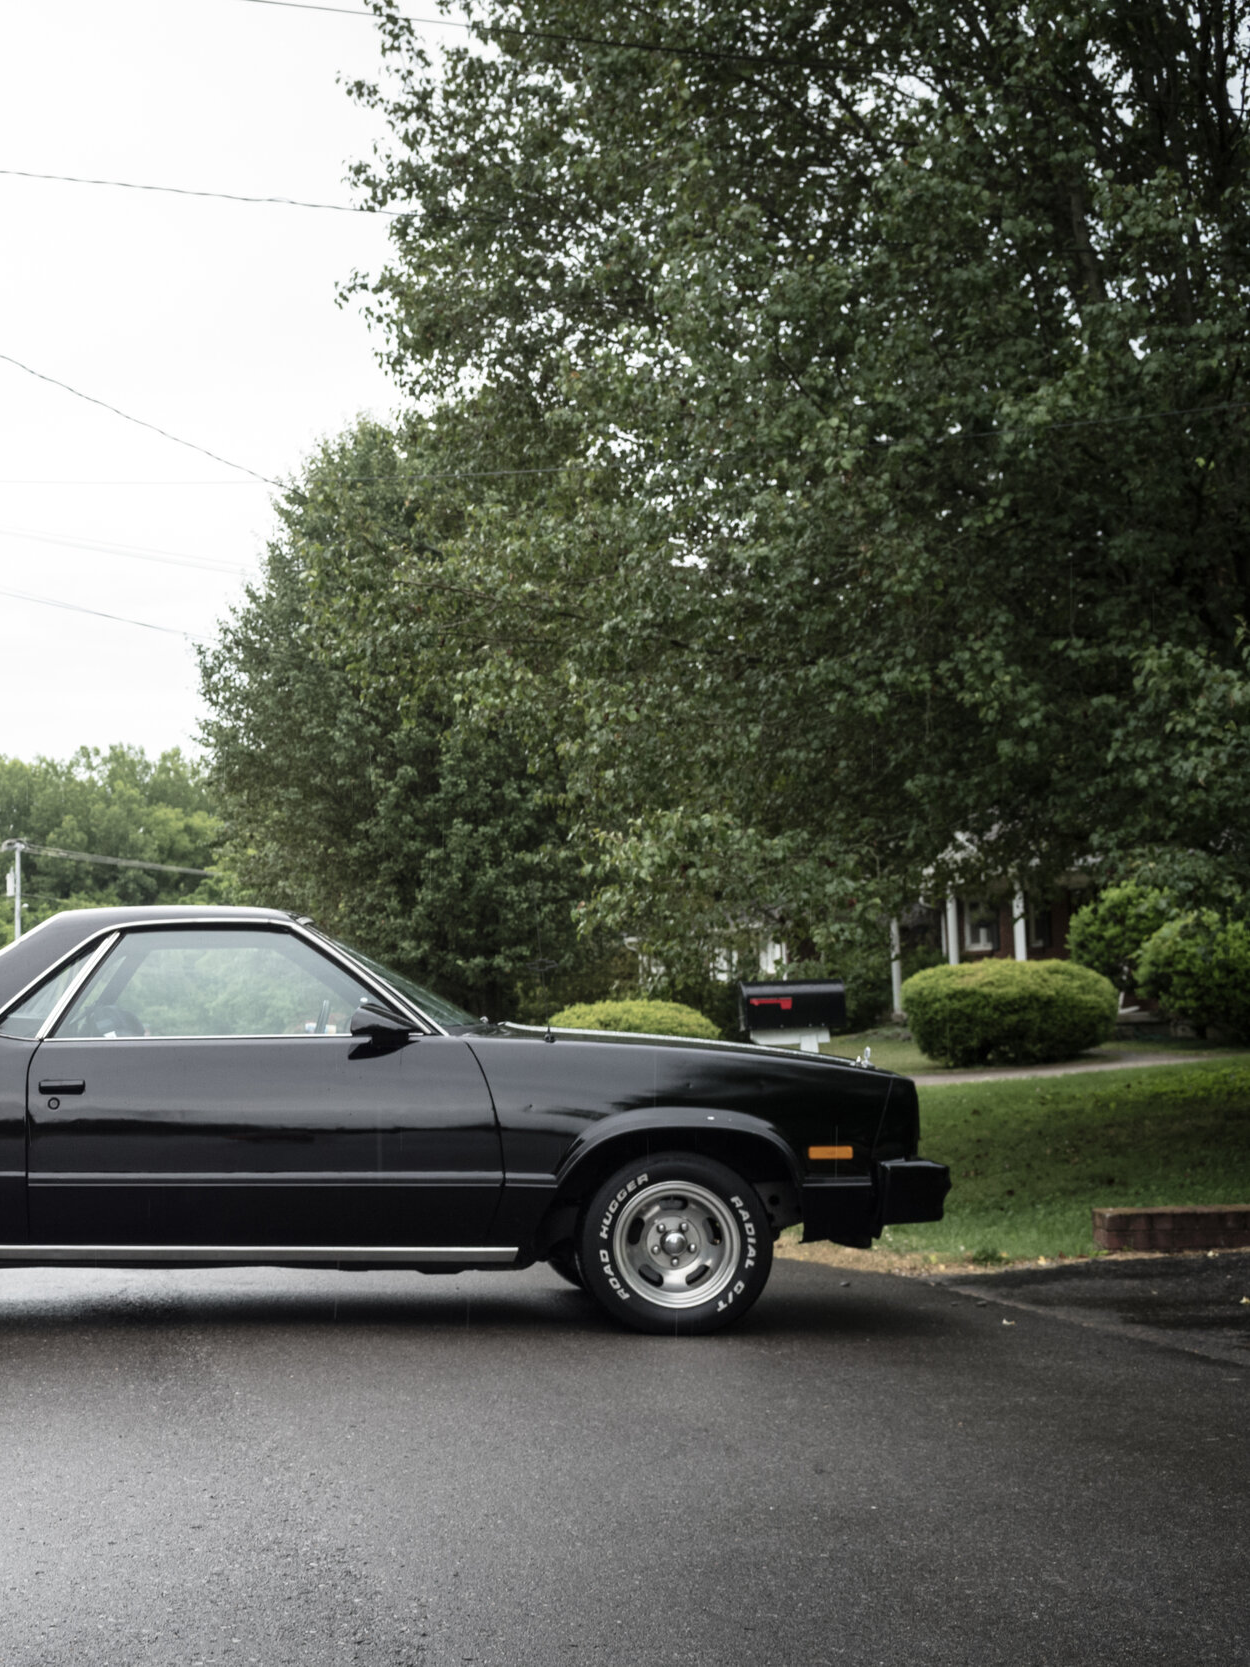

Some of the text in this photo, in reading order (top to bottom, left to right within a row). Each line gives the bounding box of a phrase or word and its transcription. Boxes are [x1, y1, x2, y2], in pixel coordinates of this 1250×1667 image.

[599, 1173, 649, 1300] ROAD HUGGER
[716, 1195, 757, 1312] RADIAL G/T
